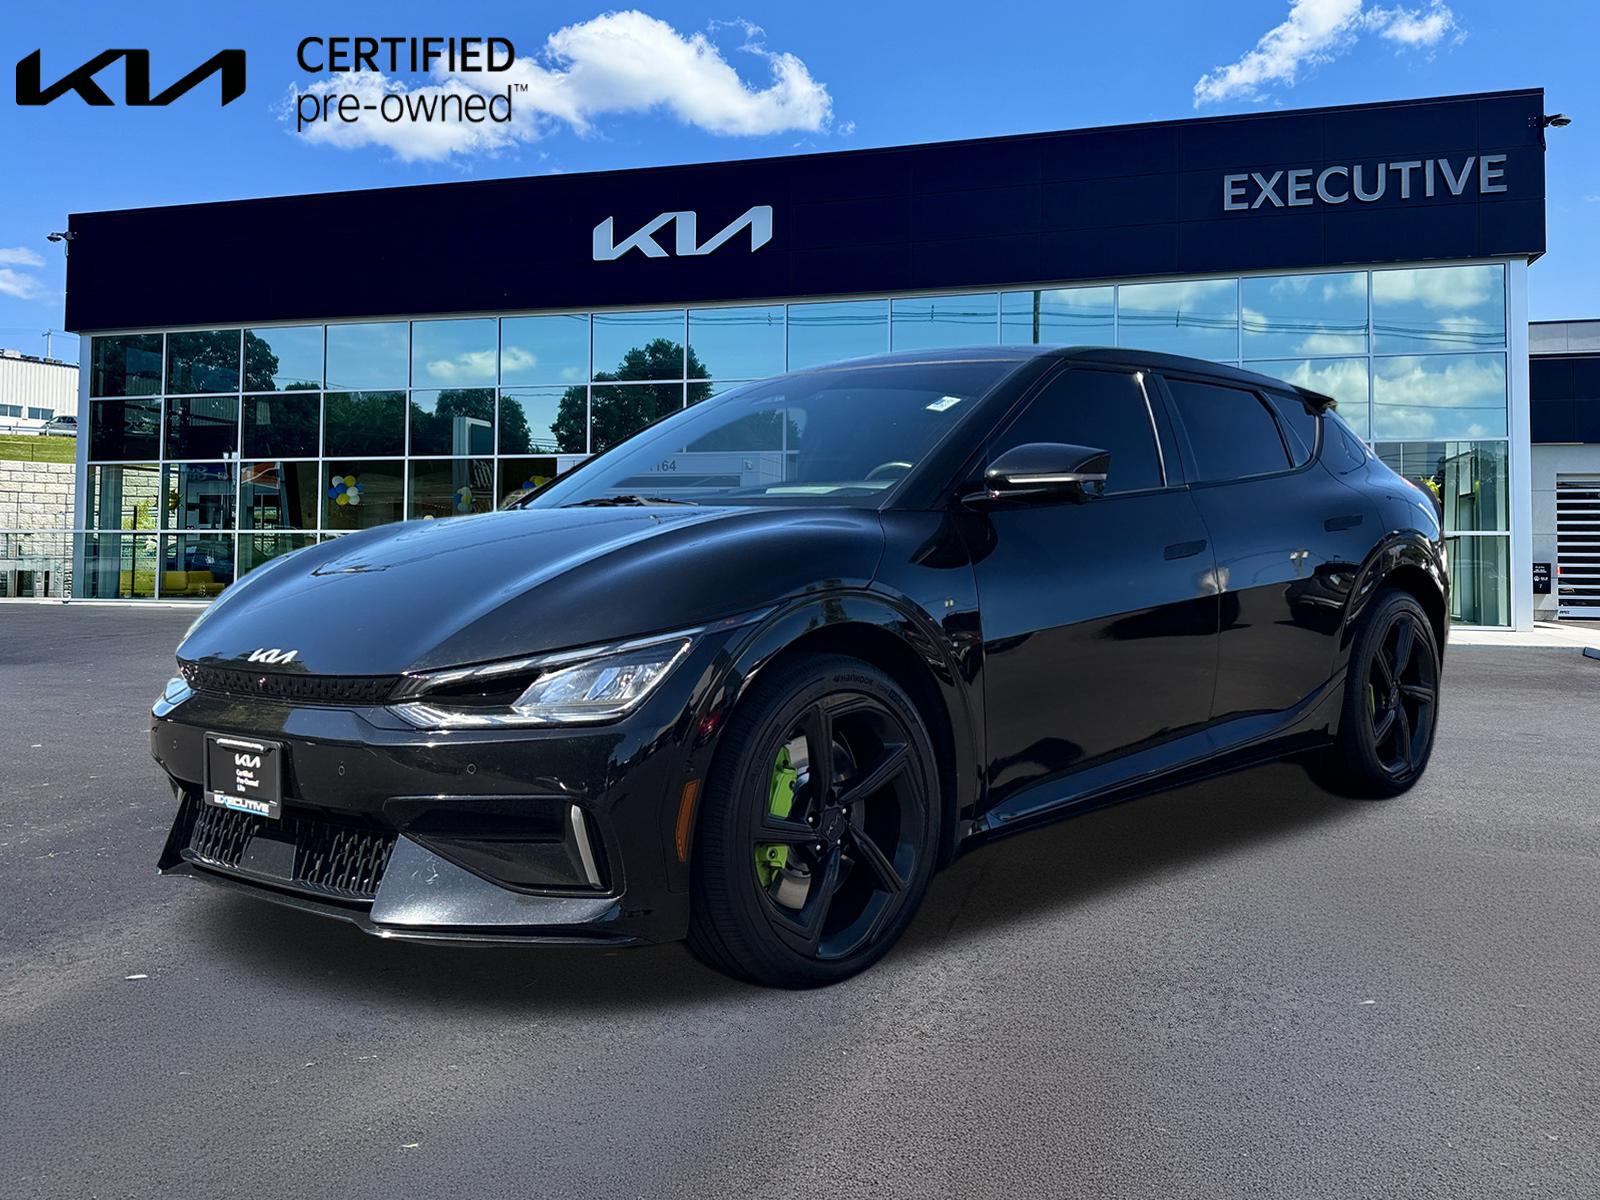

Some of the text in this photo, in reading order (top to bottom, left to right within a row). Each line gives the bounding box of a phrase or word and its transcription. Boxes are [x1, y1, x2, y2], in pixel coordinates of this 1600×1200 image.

[1223, 154, 1508, 212] EXECUTIVE
[592, 205, 773, 261] KIA
[247, 648, 298, 664] KIA
[235, 753, 261, 768] KIA
[214, 794, 269, 813] EXECUTIVE
